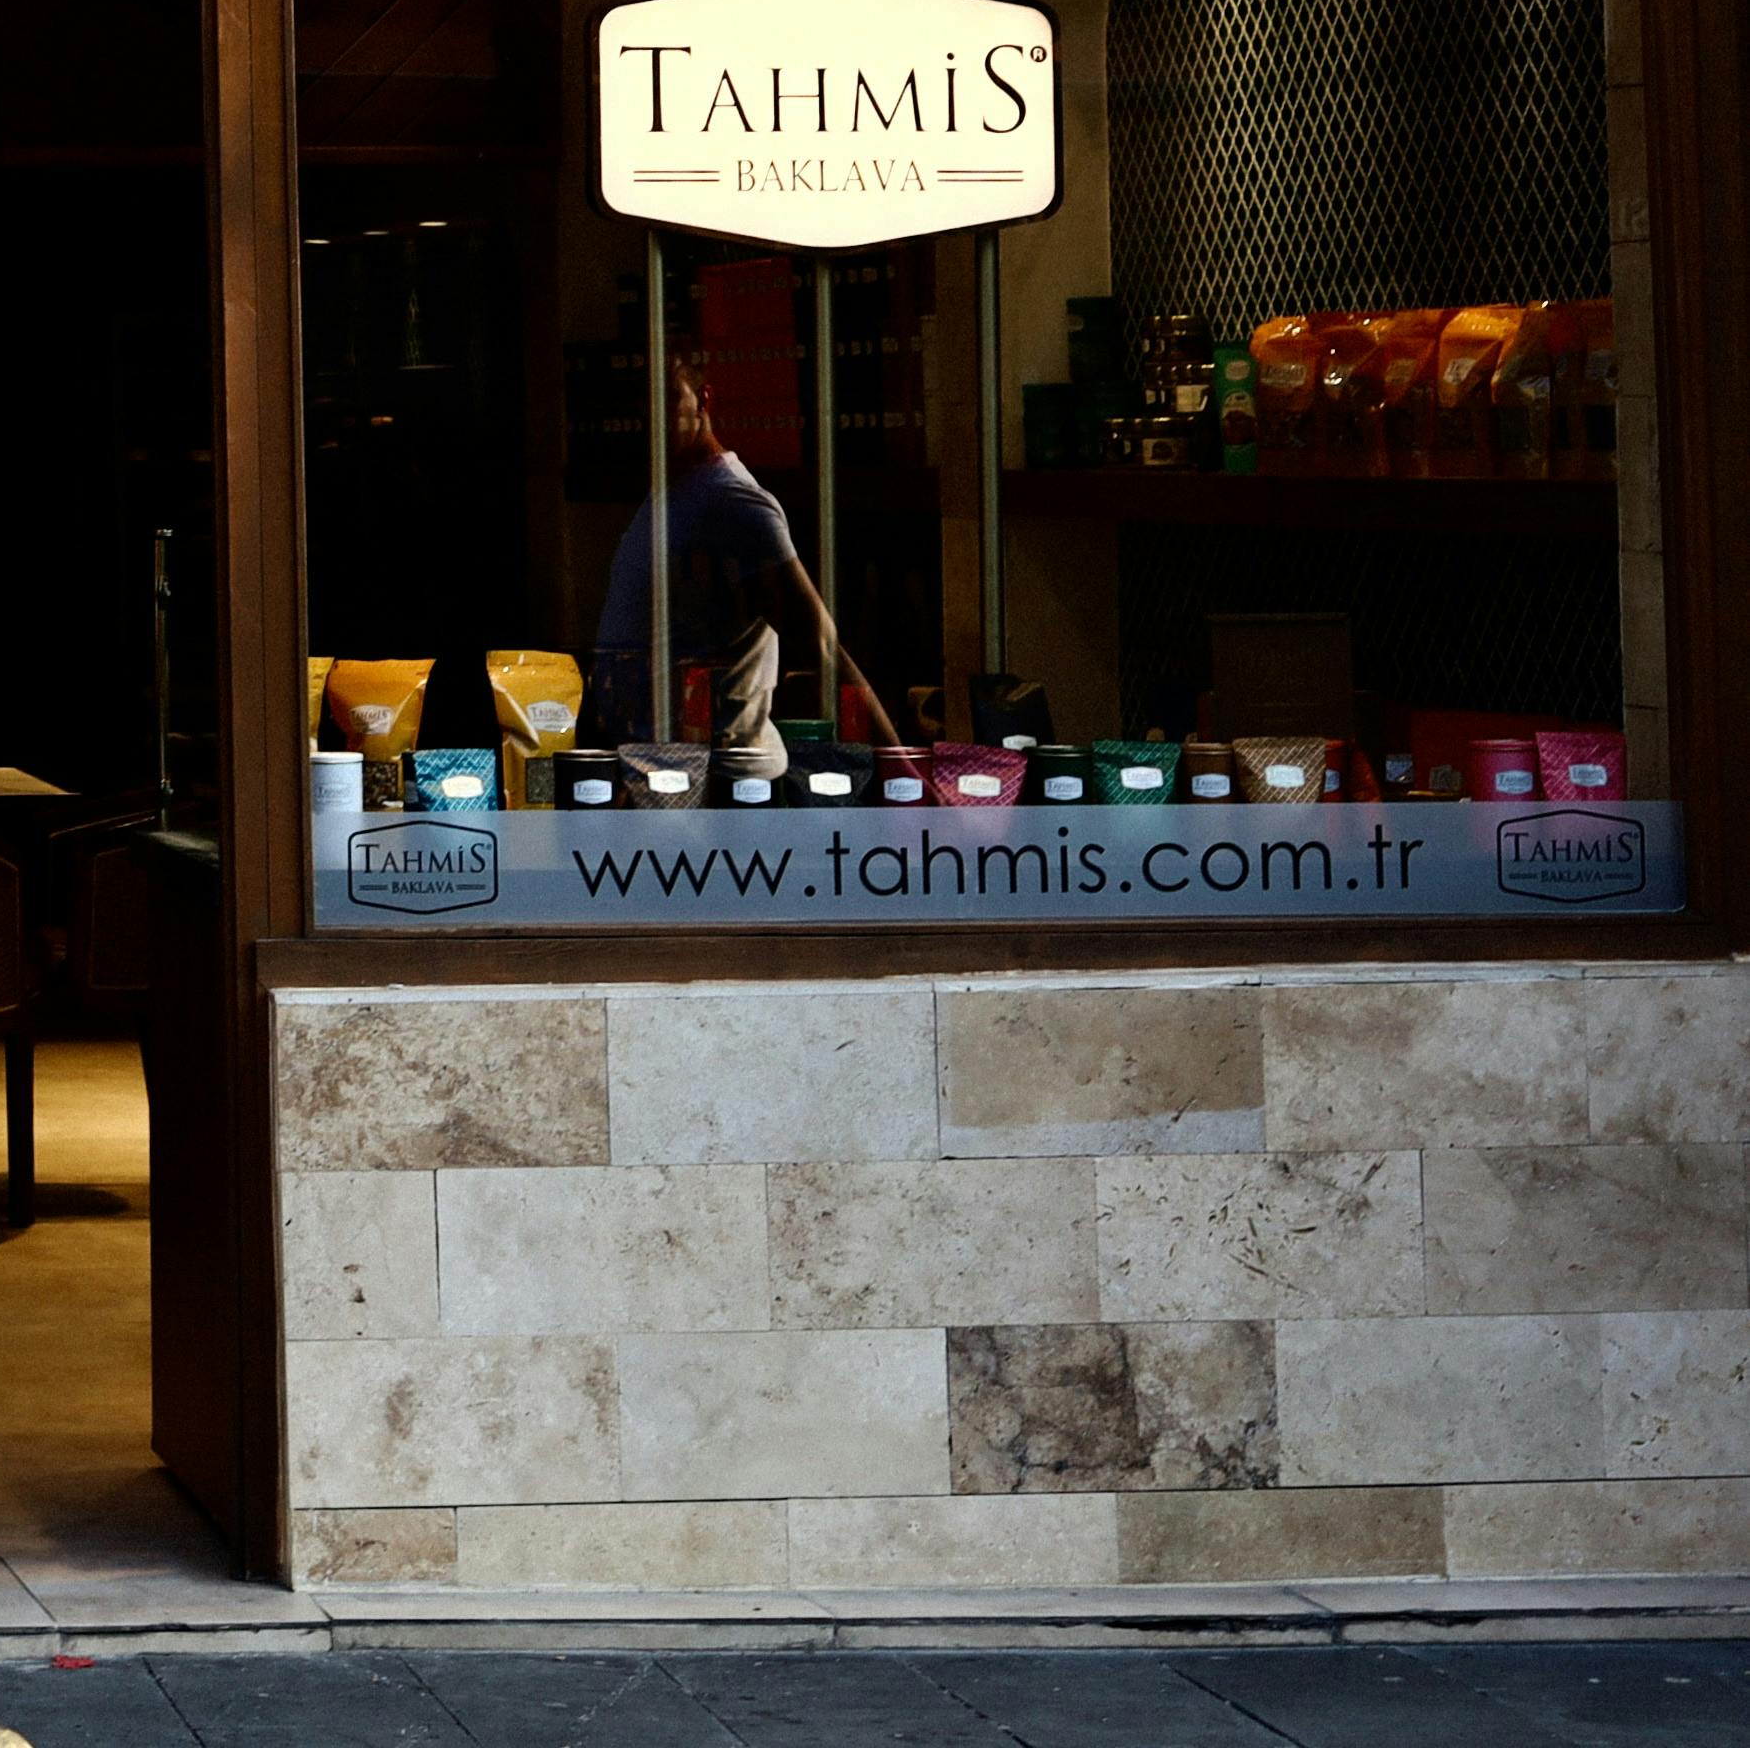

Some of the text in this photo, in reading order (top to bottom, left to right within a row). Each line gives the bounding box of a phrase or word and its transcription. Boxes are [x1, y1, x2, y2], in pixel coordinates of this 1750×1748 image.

[737, 159, 926, 192] BAKLAVA
[572, 823, 1424, 898] www.tahmis.com.tr
[391, 881, 454, 894] BAKLAVA
[1540, 869, 1603, 884] BAKLAVA
